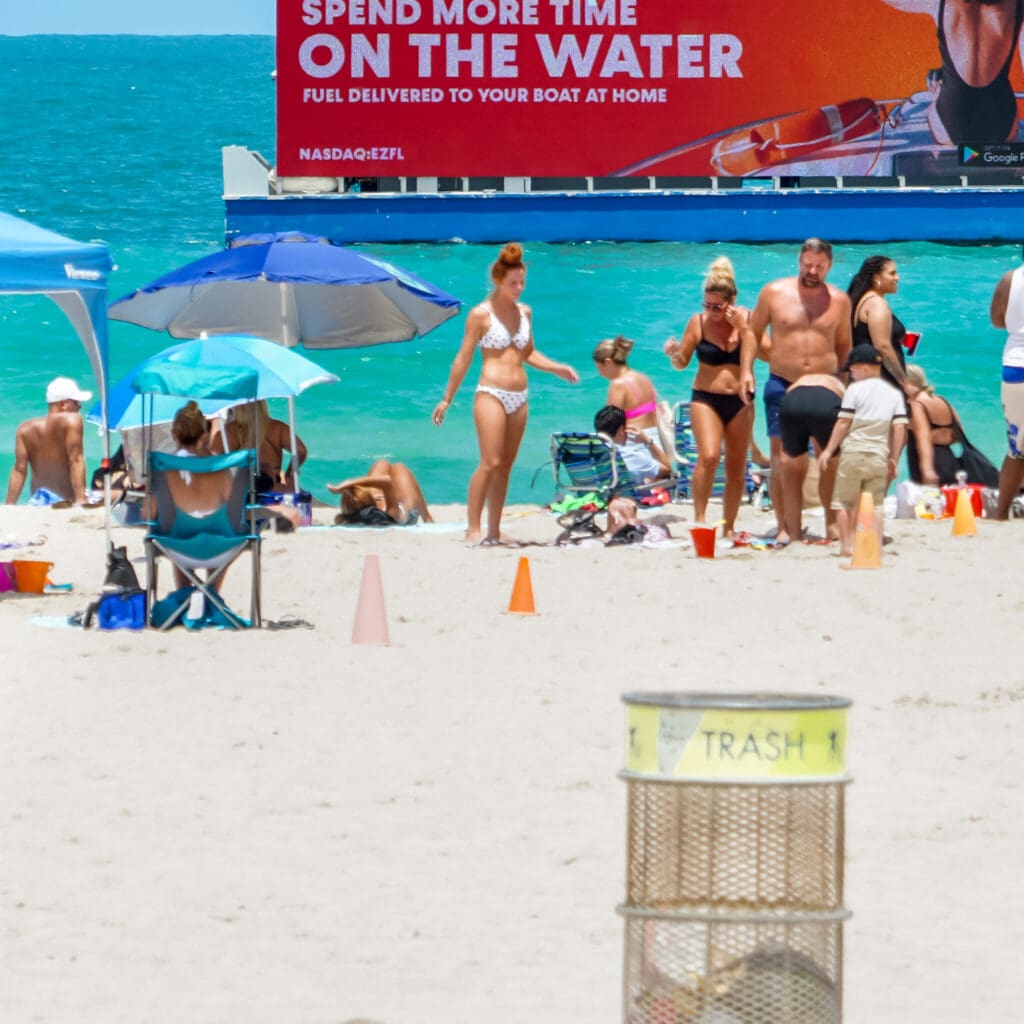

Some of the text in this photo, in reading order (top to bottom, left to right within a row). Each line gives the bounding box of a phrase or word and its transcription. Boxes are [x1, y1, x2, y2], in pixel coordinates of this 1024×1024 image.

[298, 32, 744, 79] ON THE WATER
[302, 87, 667, 104] FUEL DELIVERED TO YOUR BOAT AT HOME
[299, 147, 405, 162] NASDAQ:EZFL
[984, 152, 1018, 164] Google
[701, 730, 805, 761] TRASH
